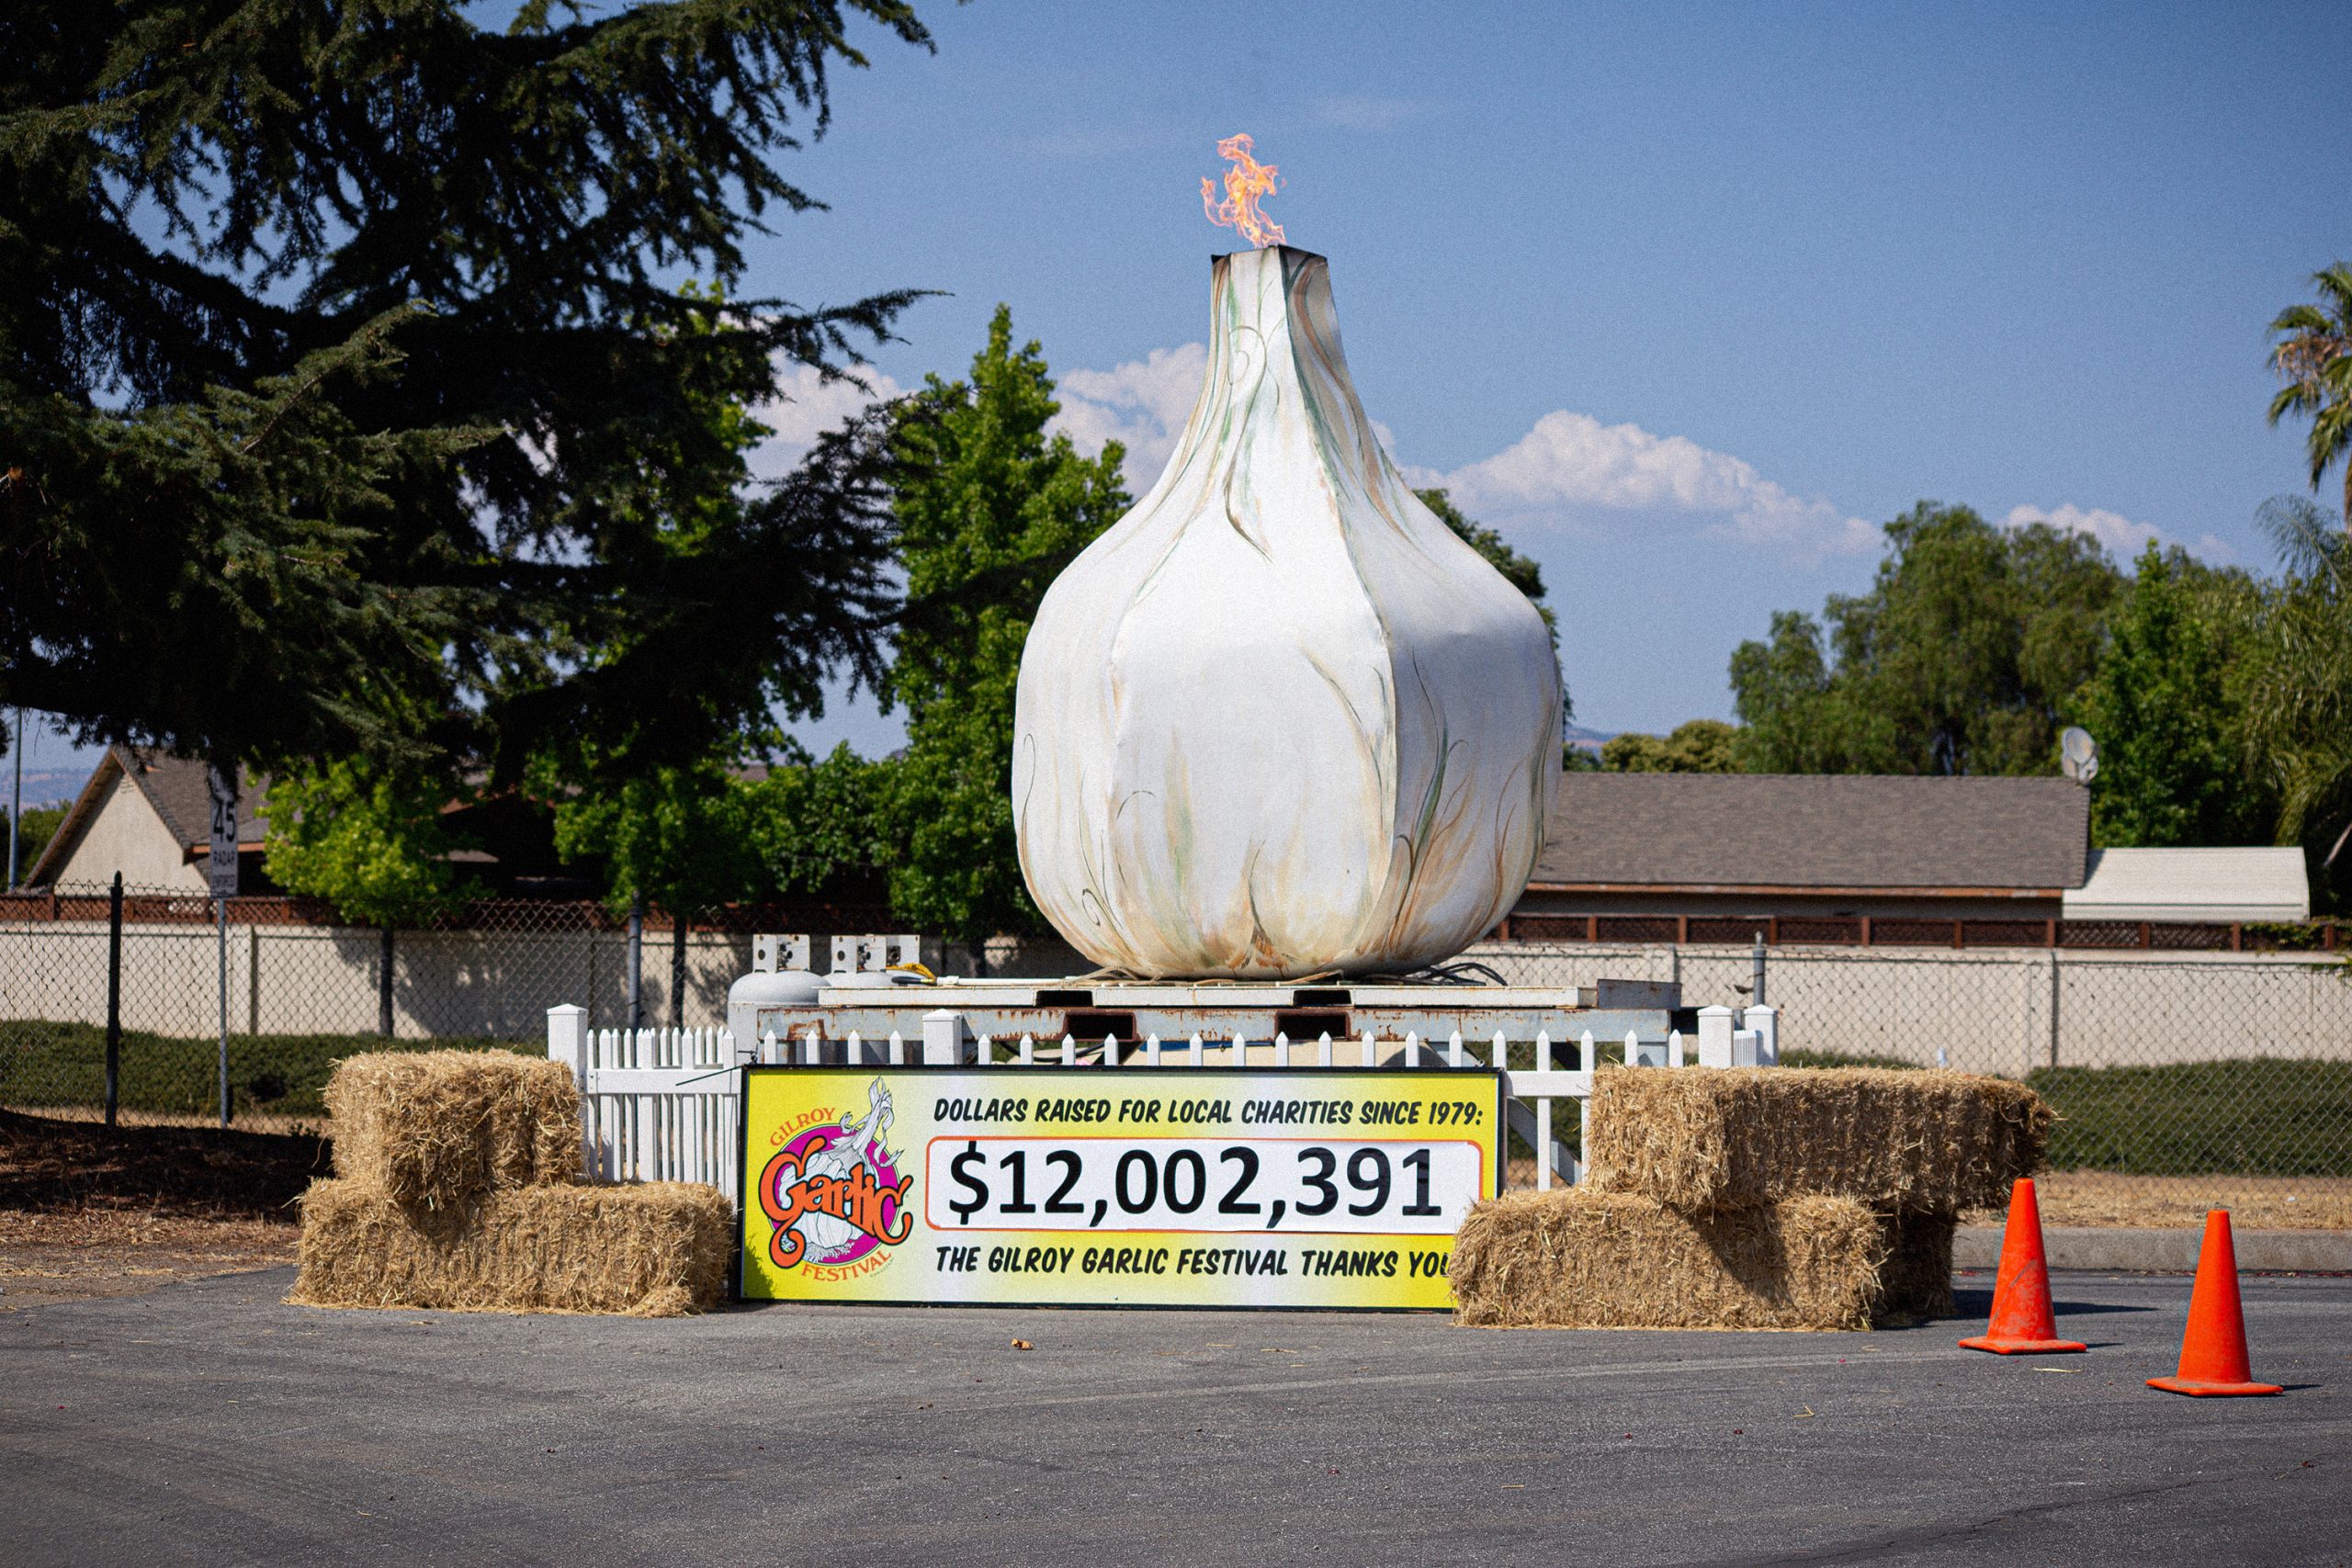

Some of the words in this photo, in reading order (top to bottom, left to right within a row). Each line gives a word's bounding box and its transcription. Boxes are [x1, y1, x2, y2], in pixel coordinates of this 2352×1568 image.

[212, 799, 236, 843] 45
[770, 1107, 836, 1146] GILROY
[934, 1099, 1028, 1122] DOLLARS
[1035, 1099, 1111, 1123] RAISED
[1118, 1099, 1161, 1123] FOR
[1168, 1100, 1232, 1123] LOCAL
[1241, 1100, 1353, 1124] CHARITIES
[1359, 1100, 1422, 1125] SINCE
[1429, 1101, 1483, 1125] 1979:
[758, 1135, 914, 1269] Garlic
[949, 1141, 1442, 1229] $12,002,391
[800, 1249, 892, 1281] FESTIVAL
[936, 1246, 981, 1272] THE
[988, 1246, 1075, 1273] GILROY
[1081, 1247, 1169, 1274] GARLIC
[1176, 1248, 1288, 1275] FESTIVAL
[1301, 1250, 1398, 1277] THANKS
